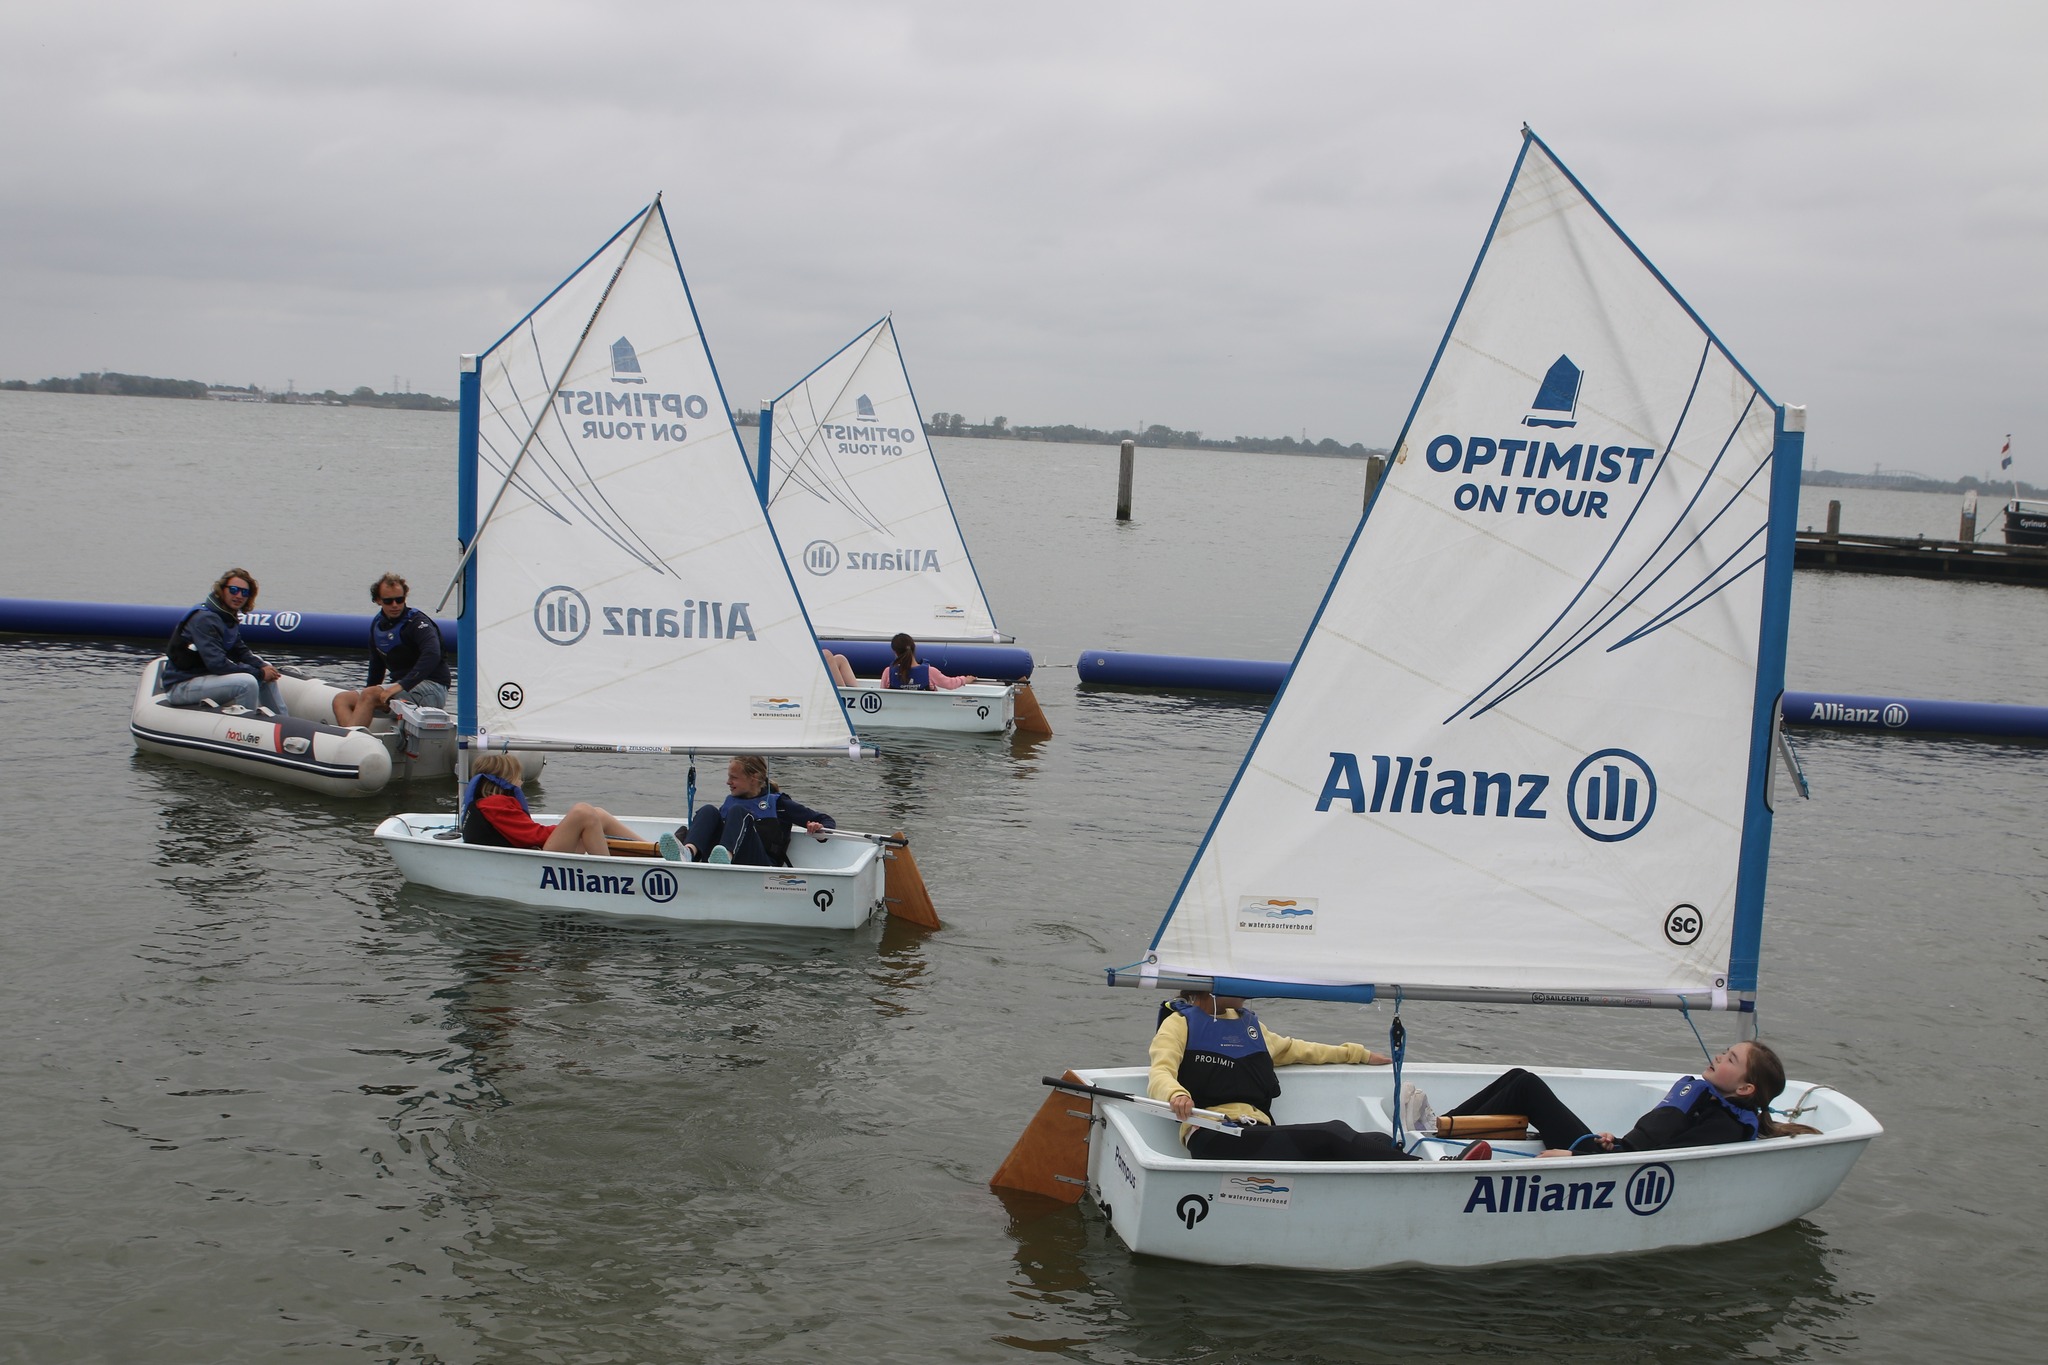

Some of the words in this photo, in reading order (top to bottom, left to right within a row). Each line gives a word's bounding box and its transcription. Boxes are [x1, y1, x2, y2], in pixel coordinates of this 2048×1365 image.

[1426, 434, 1655, 485] OPTIMIST
[1454, 483, 1508, 513] ON
[1516, 487, 1609, 519] TOUR
[2020, 519, 2047, 528] Gyrinus
[501, 690, 520, 701] SC
[1810, 702, 1880, 722] Allianz
[1315, 752, 1549, 819] Allianz
[540, 866, 636, 895] Allianz
[1248, 921, 1313, 931] watersportverbond
[1671, 916, 1697, 934] SC
[1545, 994, 1590, 1002] SAILCENTER
[1194, 1054, 1235, 1069] PROLIMIT
[1114, 1145, 1137, 1189] Pampus
[1228, 1194, 1288, 1205] watersportverbond
[1463, 1174, 1616, 1213] Allianz
